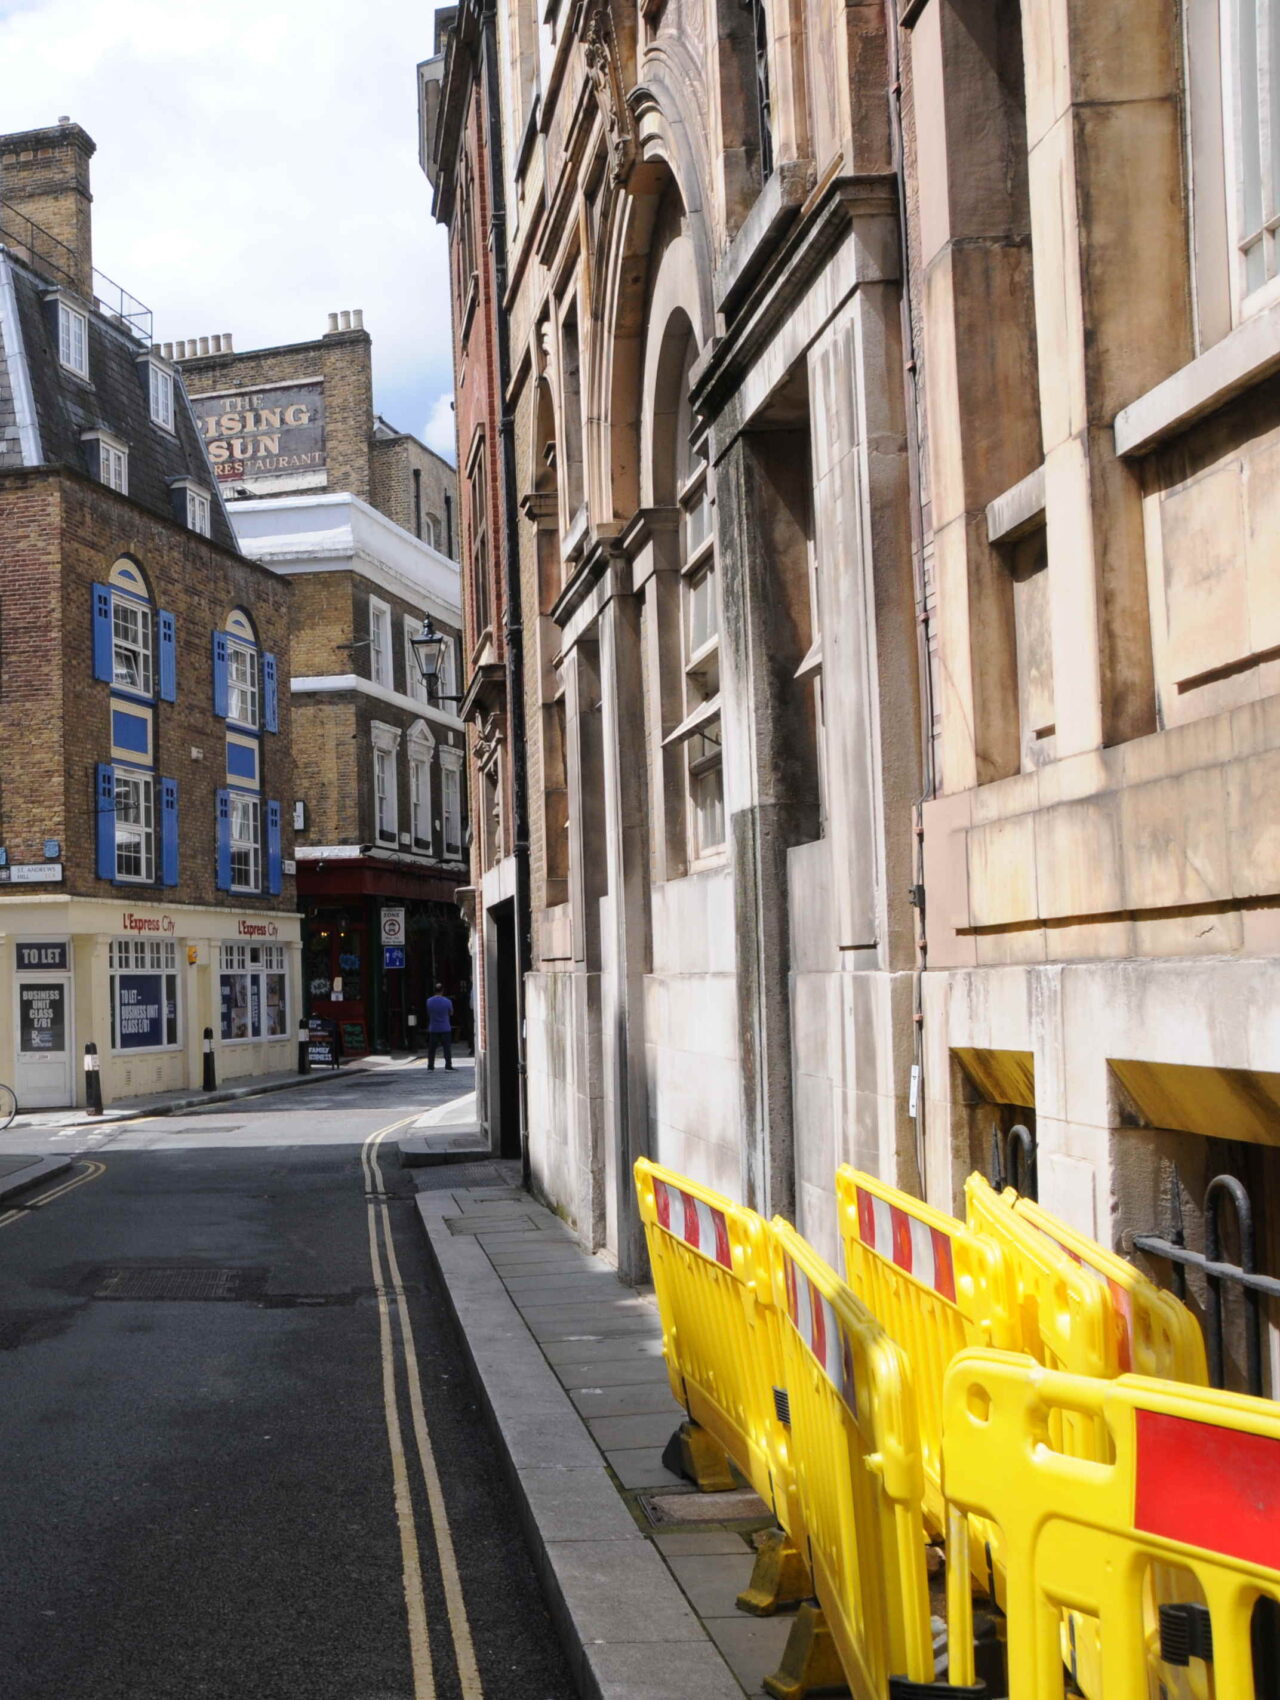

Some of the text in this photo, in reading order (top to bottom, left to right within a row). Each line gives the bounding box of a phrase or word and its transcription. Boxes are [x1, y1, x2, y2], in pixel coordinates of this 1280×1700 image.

[221, 394, 264, 412] THE
[208, 433, 281, 463] SUN
[215, 452, 322, 475] RESTAURANT
[123, 913, 176, 936] L'Express City
[22, 948, 61, 964] TO LET
[24, 990, 60, 1000] BUSINESS
[32, 1000, 50, 1009] UNIT
[29, 1008, 54, 1019] CLASS
